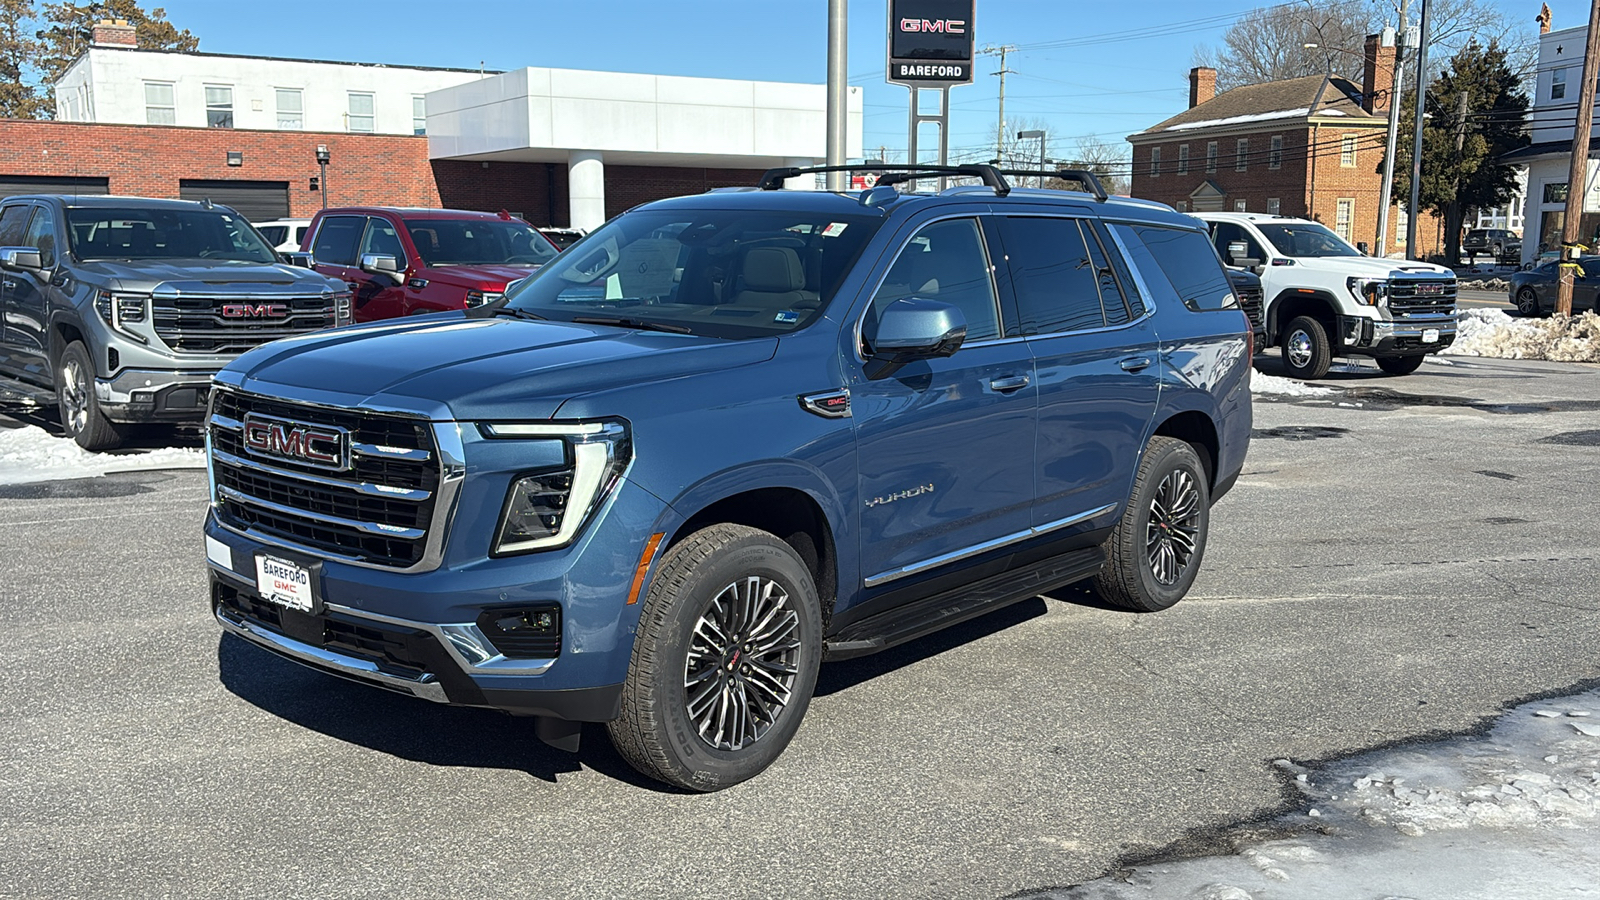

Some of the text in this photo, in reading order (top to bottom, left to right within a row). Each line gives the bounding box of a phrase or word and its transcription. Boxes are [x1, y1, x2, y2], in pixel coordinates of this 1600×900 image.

[900, 18, 965, 33] GMC
[900, 65, 962, 77] BAREFORD
[222, 304, 287, 317] GMC
[827, 398, 845, 406] GMC
[246, 421, 339, 464] GMC
[865, 483, 934, 507] YUKON
[263, 561, 307, 585] BAREFORD
[273, 580, 298, 594] GMC
